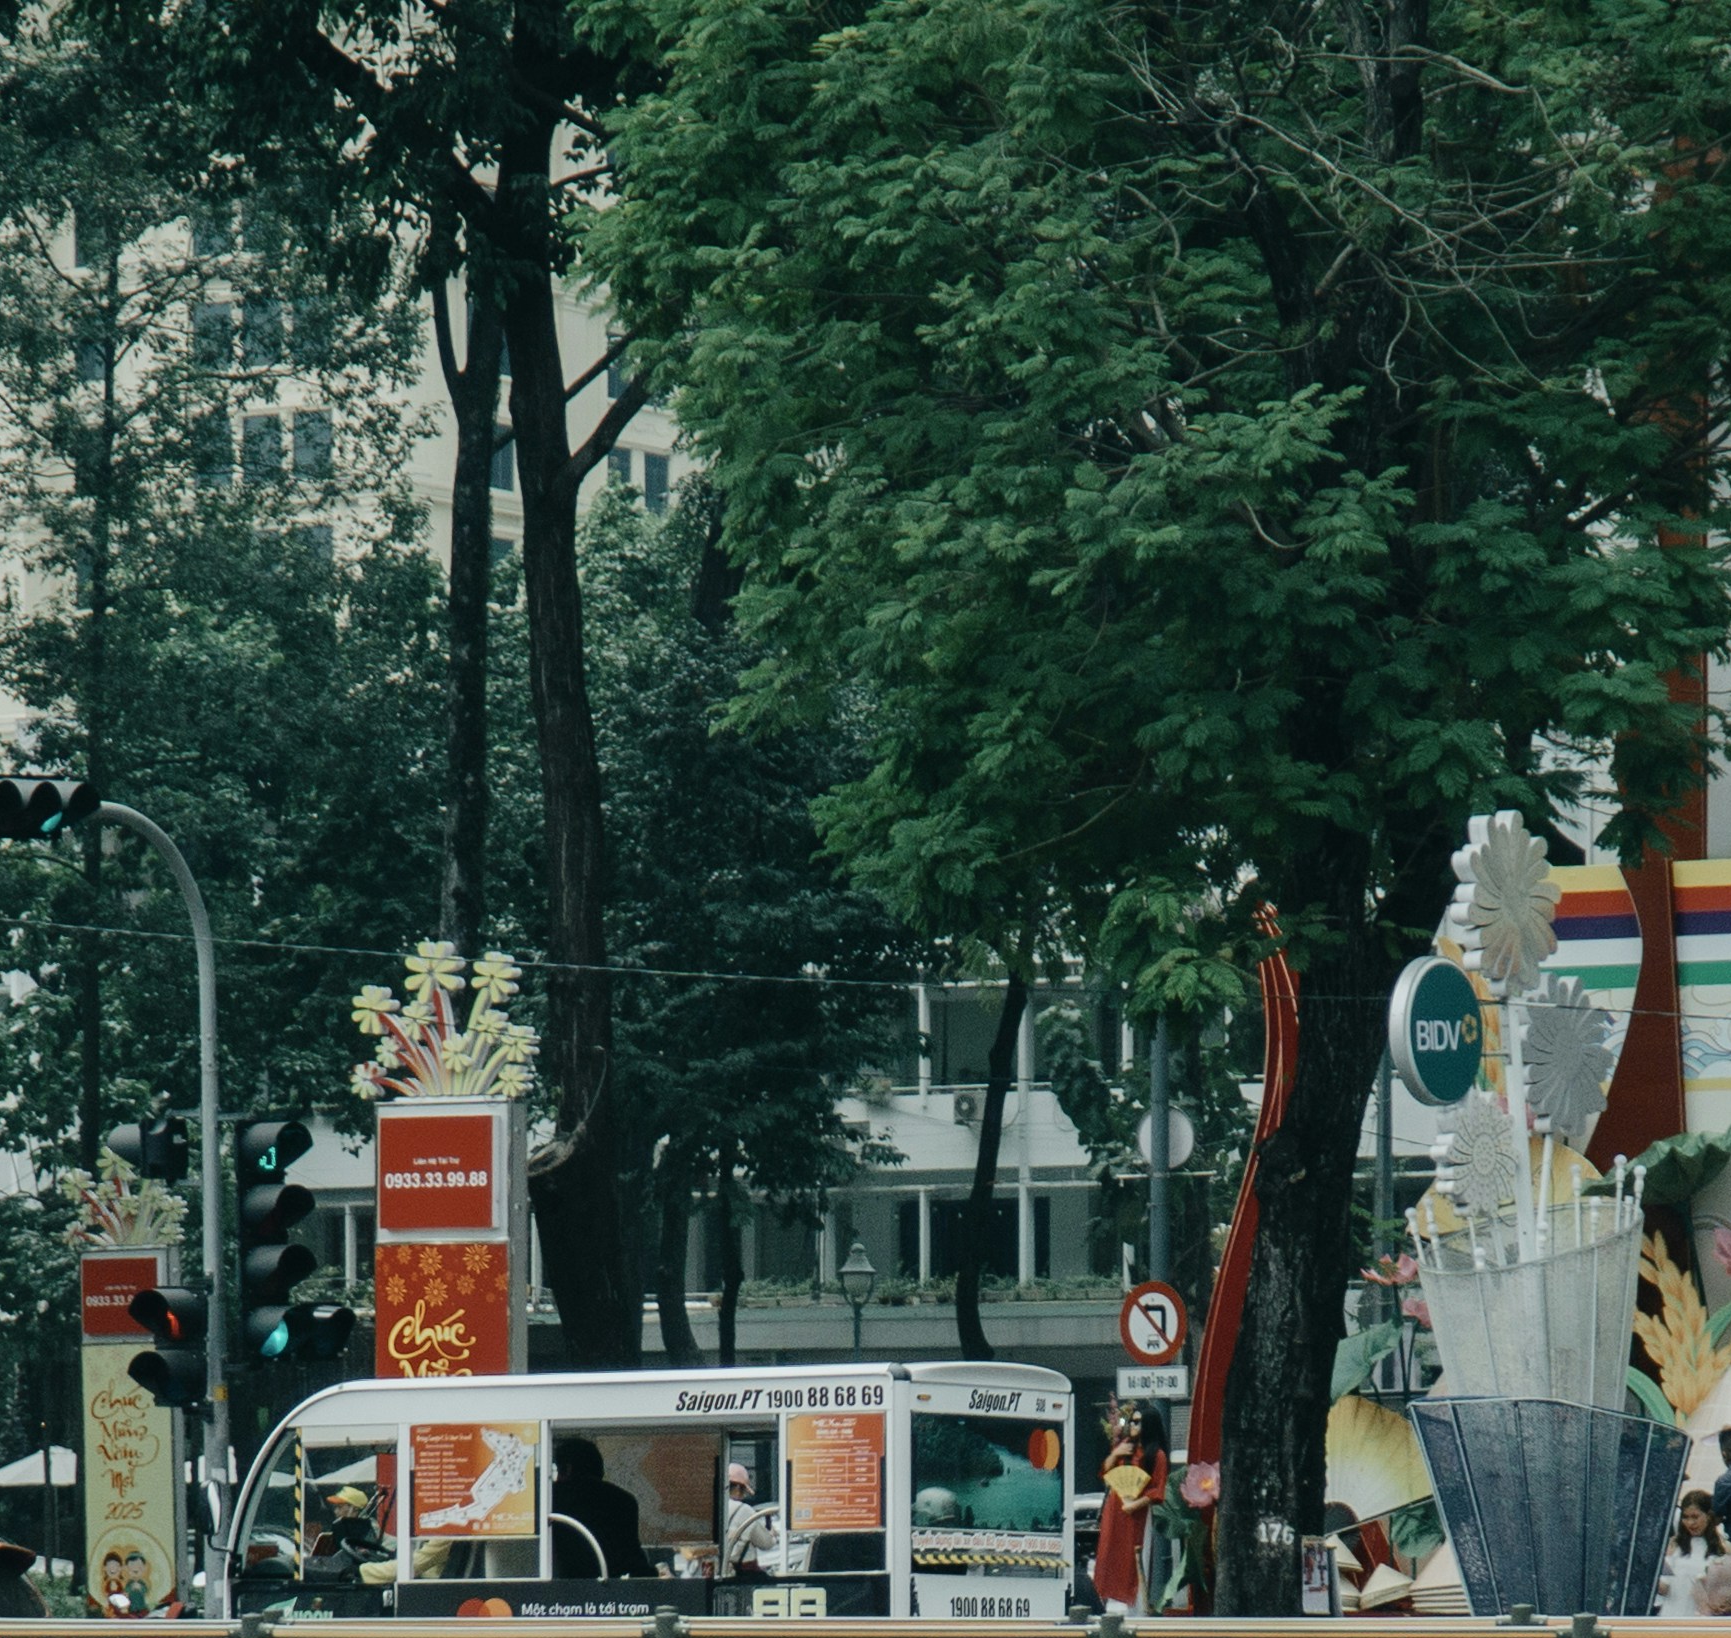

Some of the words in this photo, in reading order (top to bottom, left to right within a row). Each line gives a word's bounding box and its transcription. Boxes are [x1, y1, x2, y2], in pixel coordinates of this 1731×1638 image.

[1416, 1020, 1462, 1051] BIDV
[385, 1171, 488, 1189] 0933.33.99.88
[388, 1299, 476, 1360] Chúc
[676, 1388, 765, 1413] Saigon.PT
[766, 1389, 803, 1409] 1900
[808, 1387, 829, 1407] 88
[834, 1386, 856, 1406] 68
[862, 1385, 884, 1405] 69
[969, 1389, 1022, 1413] Saigon.PT
[105, 1500, 148, 1520] 2025
[1258, 1522, 1295, 1546] 176
[521, 1602, 546, 1617] Một
[548, 1602, 582, 1617] chạm
[585, 1601, 596, 1615] là
[599, 1601, 616, 1615] tới
[618, 1602, 649, 1616] trạm
[950, 1597, 978, 1617] 1900
[981, 1597, 995, 1617] 88
[998, 1597, 1012, 1617] 68
[1016, 1598, 1030, 1617] 69
